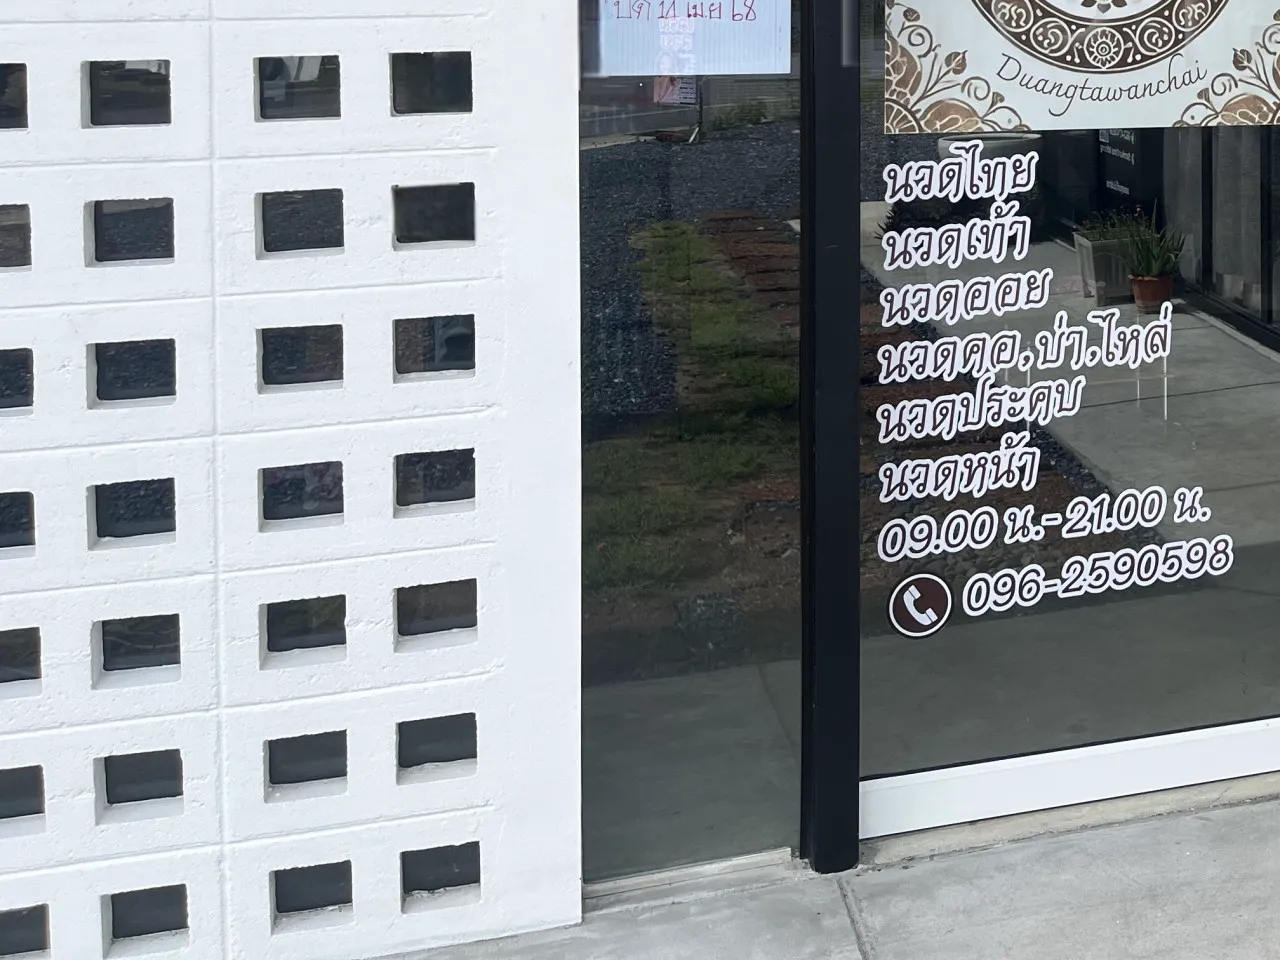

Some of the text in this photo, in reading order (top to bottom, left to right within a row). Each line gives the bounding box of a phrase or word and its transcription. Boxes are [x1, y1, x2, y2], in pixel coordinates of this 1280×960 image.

[996, 53, 1207, 116] Duangtawanchai
[883, 140, 1039, 203] นวดไทย
[882, 201, 1031, 270] นวดเท้า
[880, 268, 1053, 327] นวดออย
[877, 300, 1173, 384] นวดคอ,บ่า,ไหล่
[876, 373, 1086, 443] นวดประคบ
[879, 432, 1040, 502] นวดหน้า
[878, 508, 998, 562] 09.00
[1173, 485, 1211, 524] น.
[962, 535, 1235, 617] 096-2590598
